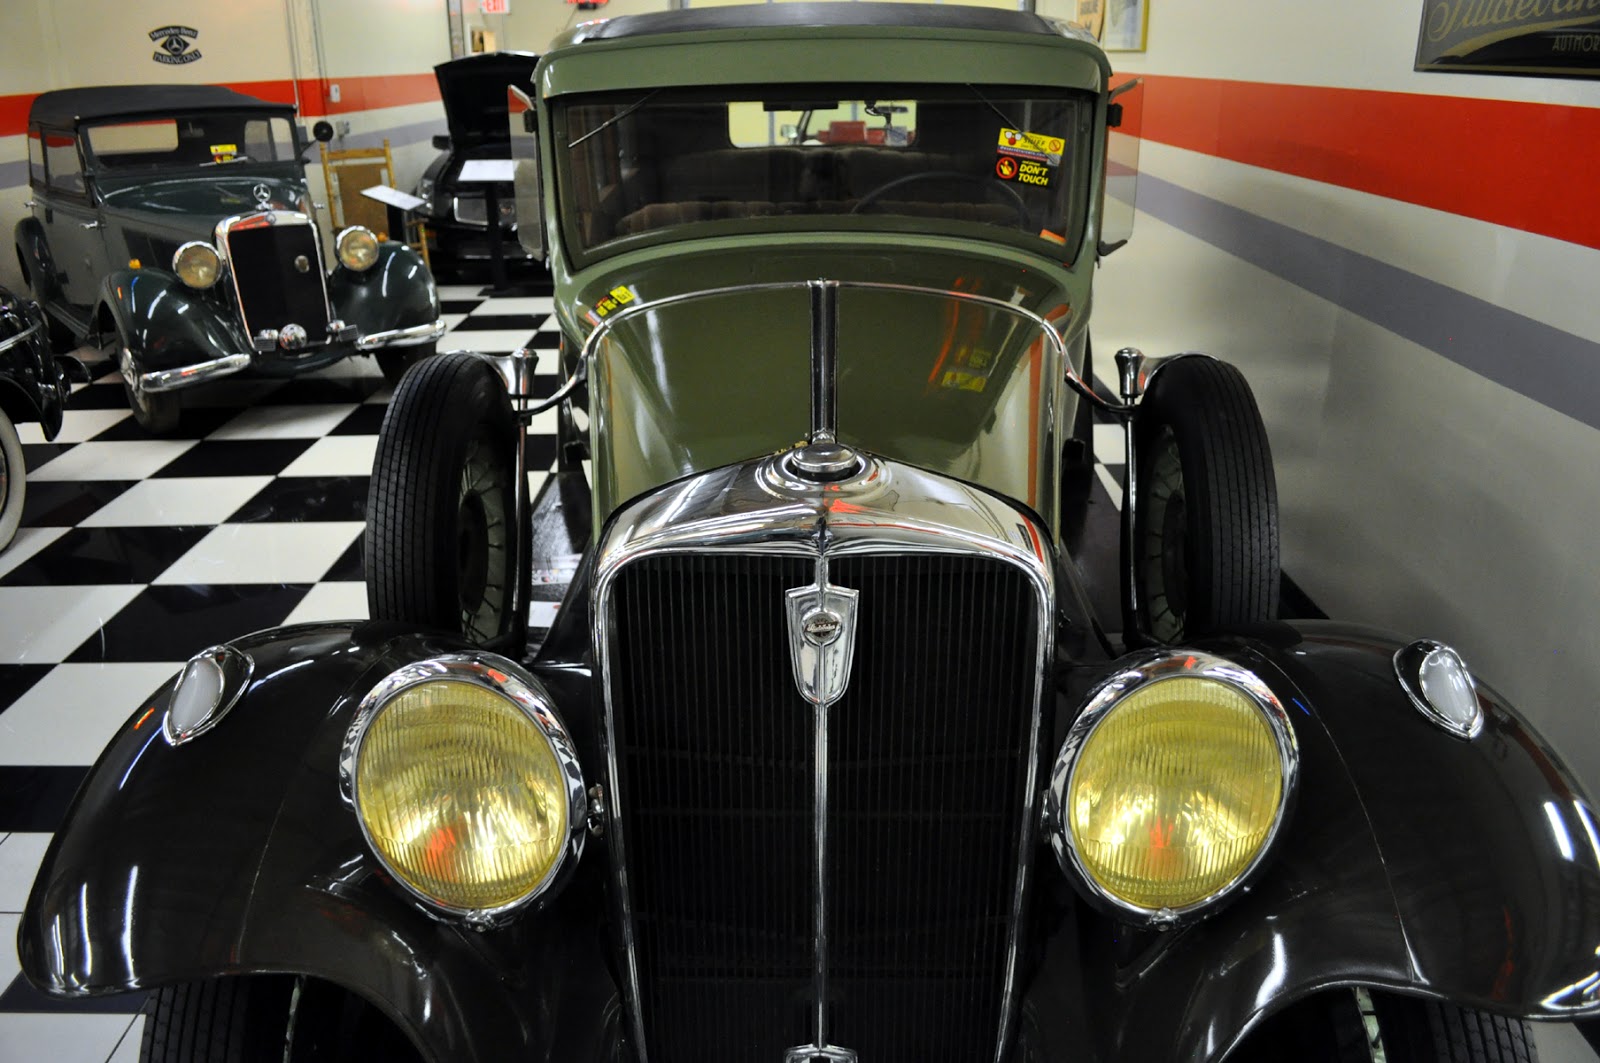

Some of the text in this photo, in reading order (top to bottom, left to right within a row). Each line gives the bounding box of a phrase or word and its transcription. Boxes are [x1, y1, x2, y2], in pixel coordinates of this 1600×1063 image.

[154, 50, 200, 64] PARKING ONLY
[1019, 163, 1048, 176] DON'T
[1018, 173, 1049, 186] TOUCH
